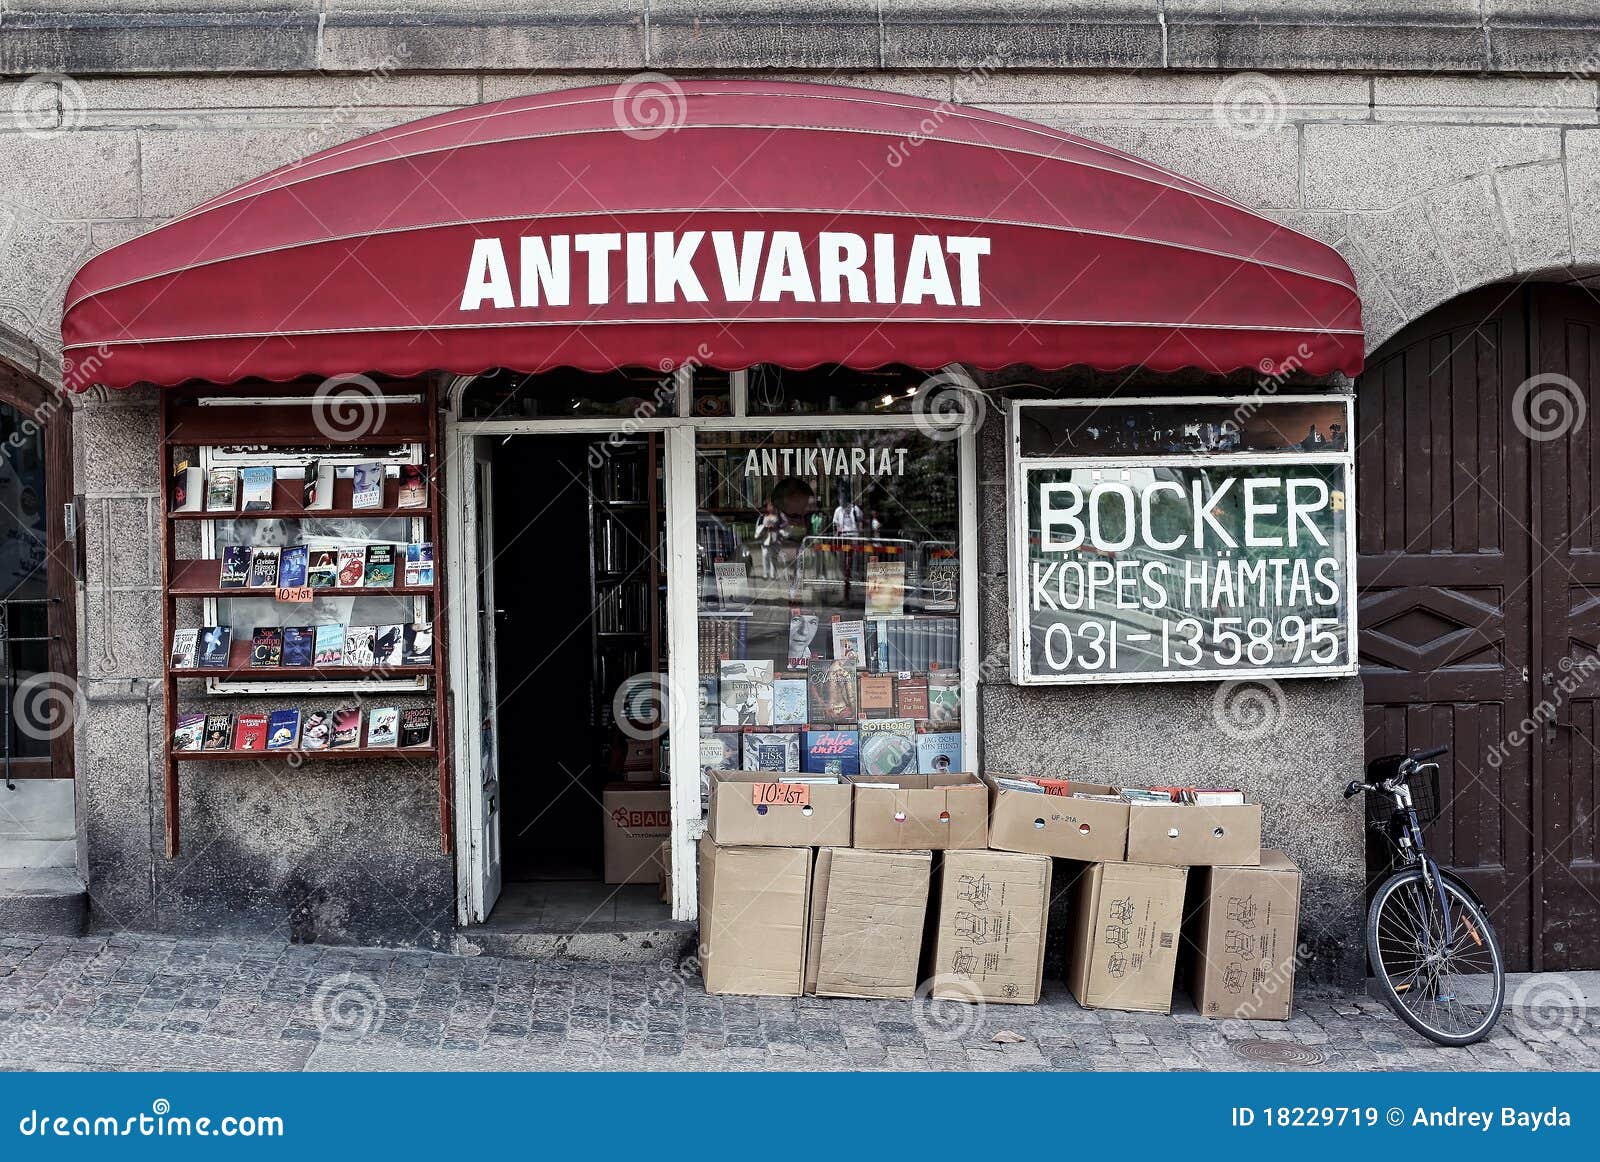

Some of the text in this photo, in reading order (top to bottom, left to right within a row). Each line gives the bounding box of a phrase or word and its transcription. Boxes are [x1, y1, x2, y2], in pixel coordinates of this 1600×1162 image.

[459, 231, 991, 311] ANTIKVARIAT
[744, 447, 909, 477] ANTIKVARIAT
[1039, 469, 1331, 552] BÖCKER
[928, 571, 957, 581] BACK
[1032, 550, 1341, 612] KÖPES HÄMTAS
[174, 642, 195, 654] ALIBI
[1043, 615, 1339, 671] 031-135895
[862, 722, 911, 731] GÖTEBORG
[937, 741, 959, 749] HUND
[760, 752, 784, 760] FISK
